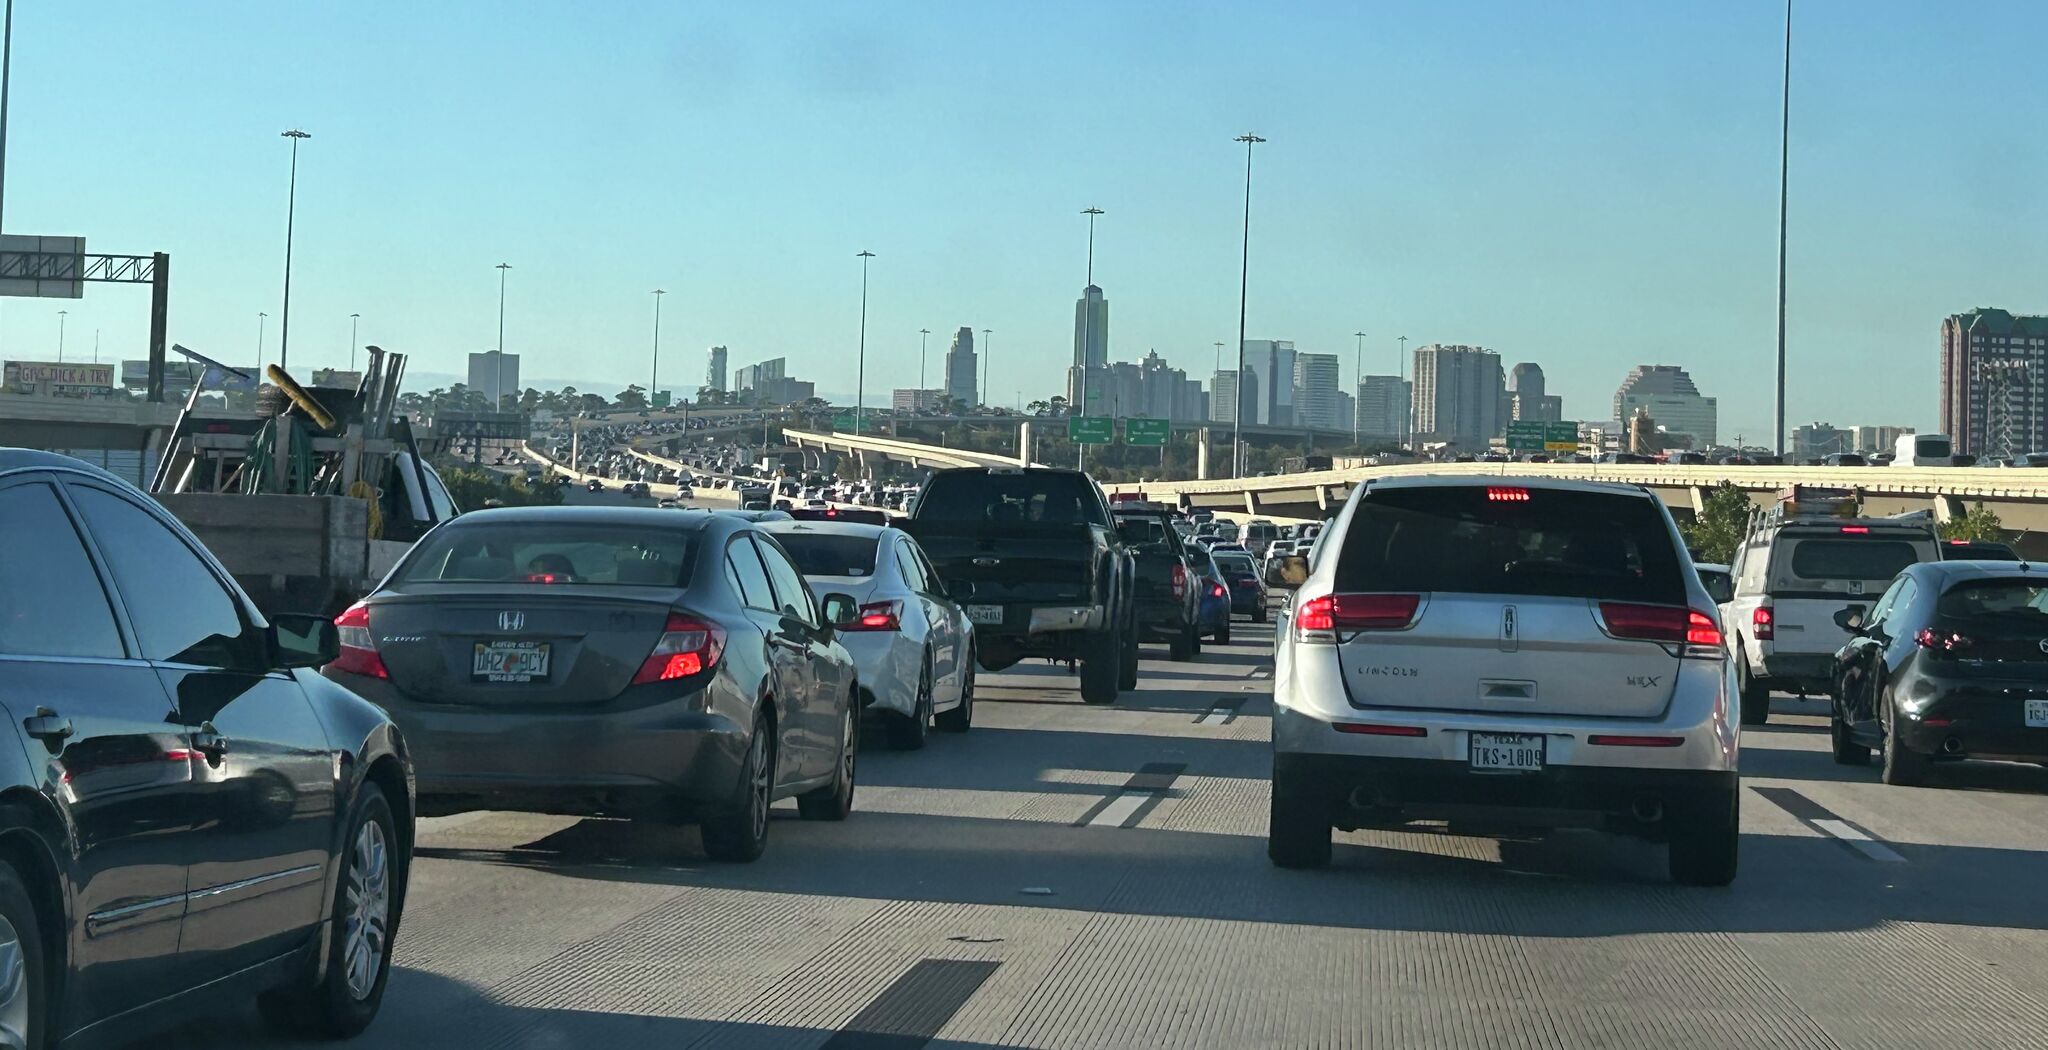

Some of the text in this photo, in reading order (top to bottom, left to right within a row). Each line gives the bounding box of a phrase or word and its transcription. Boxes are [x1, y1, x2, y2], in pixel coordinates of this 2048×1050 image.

[79, 369, 86, 384] A
[89, 369, 110, 384] TRY
[1358, 666, 1418, 677] LINCOLN
